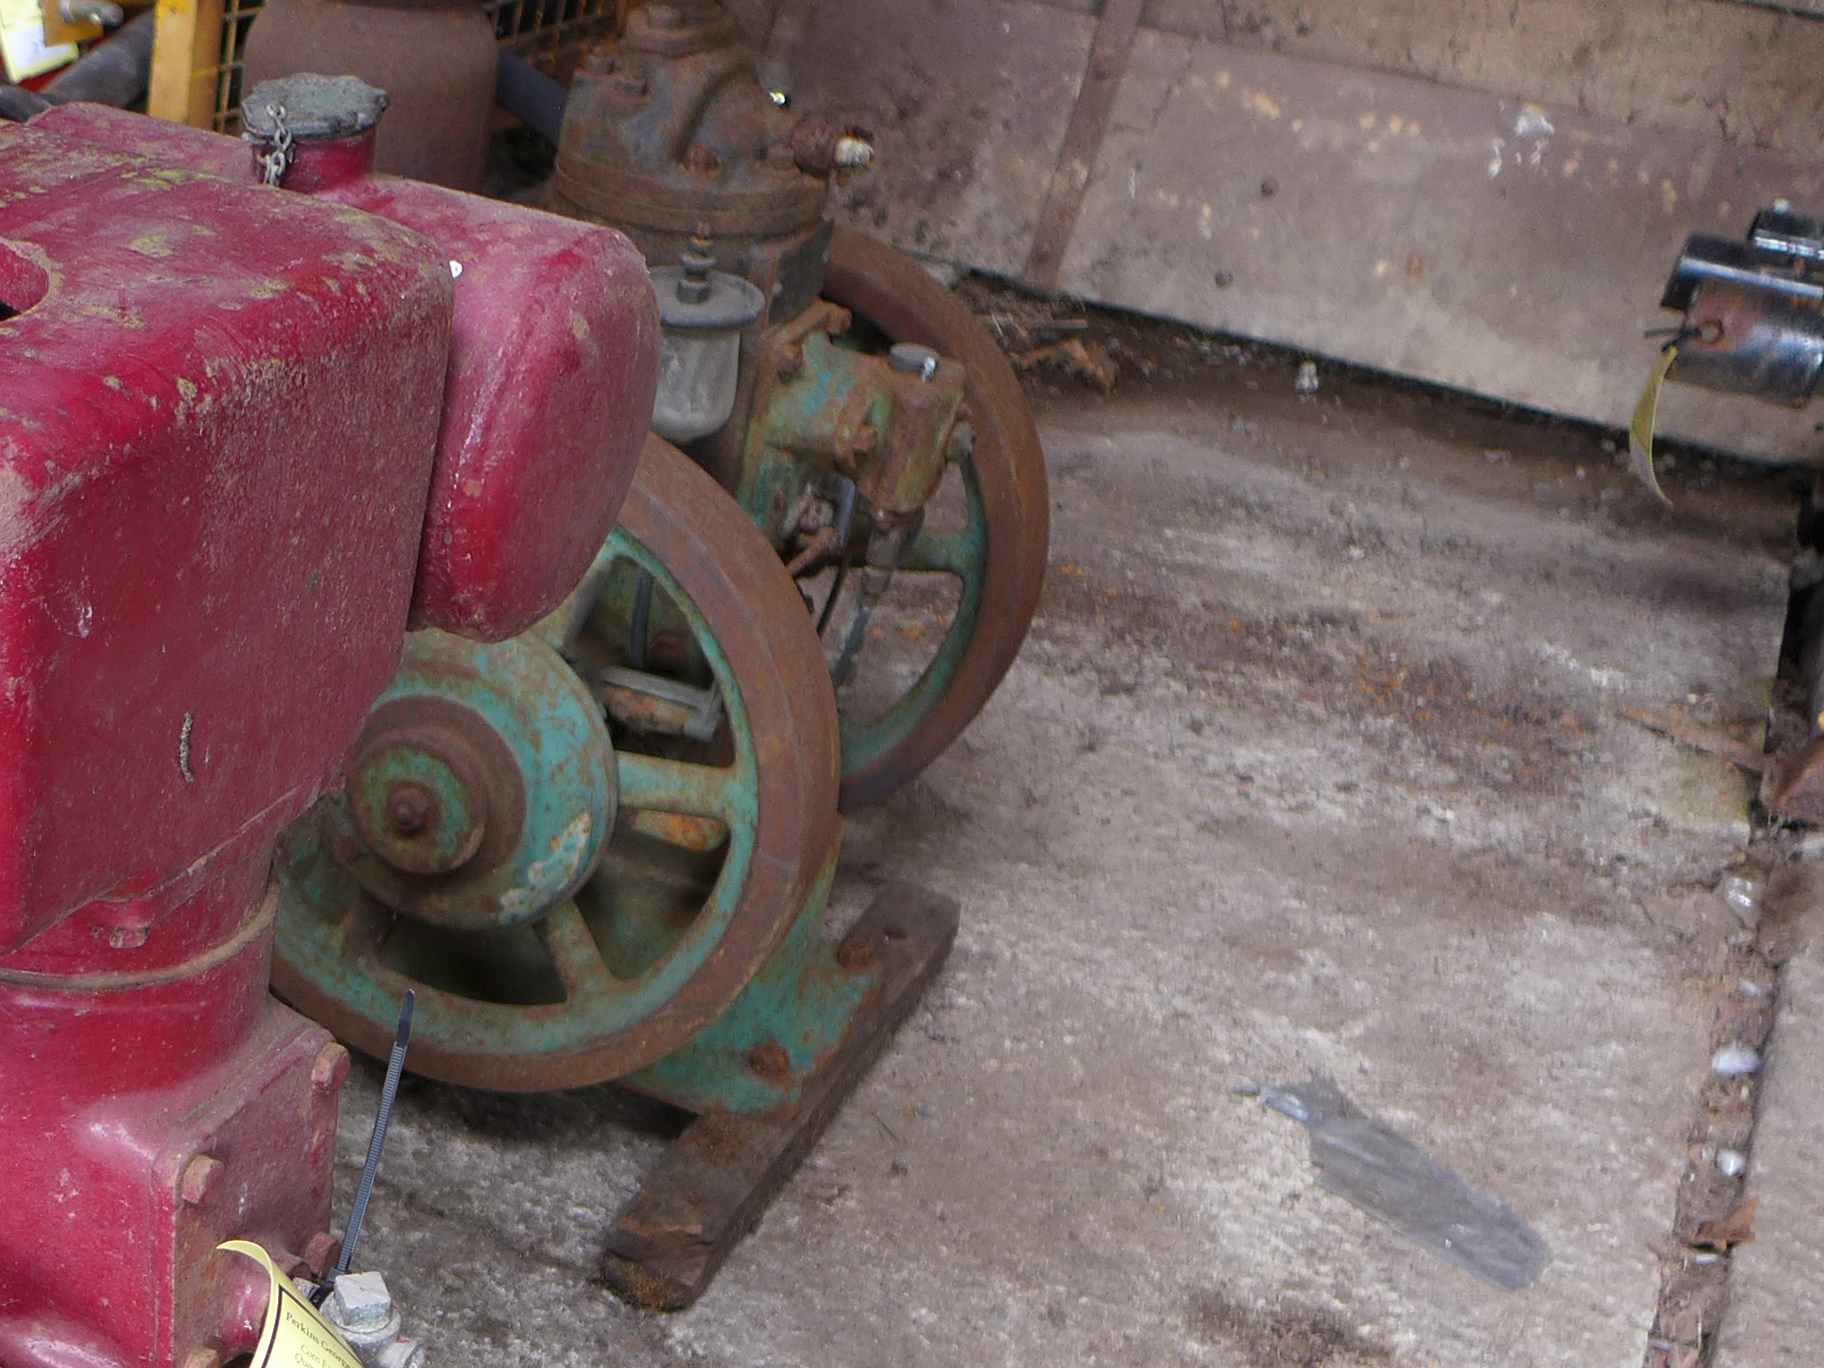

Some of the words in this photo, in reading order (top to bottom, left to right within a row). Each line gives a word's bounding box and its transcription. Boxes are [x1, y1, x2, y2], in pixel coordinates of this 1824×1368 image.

[286, 1312, 320, 1345] Perkins
[321, 1340, 350, 1368] George
[301, 1344, 320, 1363] Corn
